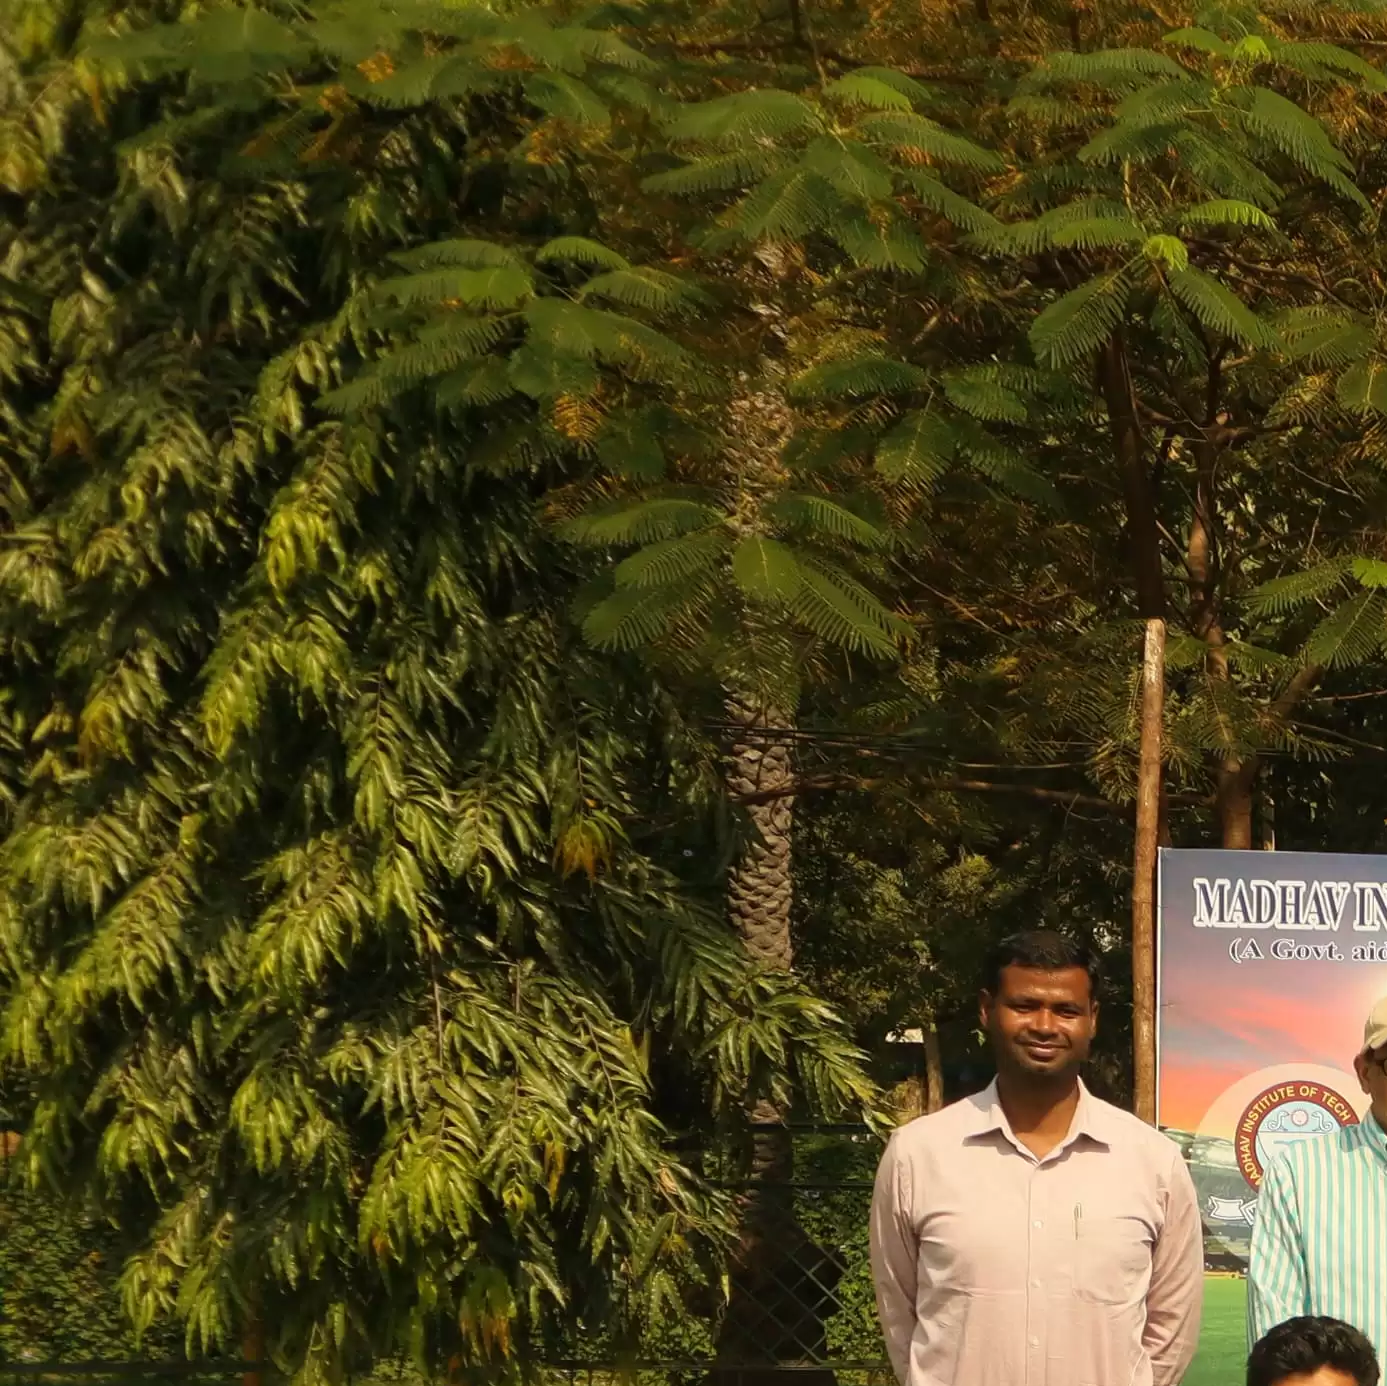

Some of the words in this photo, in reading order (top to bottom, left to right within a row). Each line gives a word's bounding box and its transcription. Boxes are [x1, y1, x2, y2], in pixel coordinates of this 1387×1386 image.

[1193, 878, 1349, 931] MADHAV
[1228, 938, 1263, 963] (A
[1271, 938, 1344, 962] Govt.
[1242, 1085, 1296, 1134] INSTITUTE
[1299, 1084, 1319, 1099] OF
